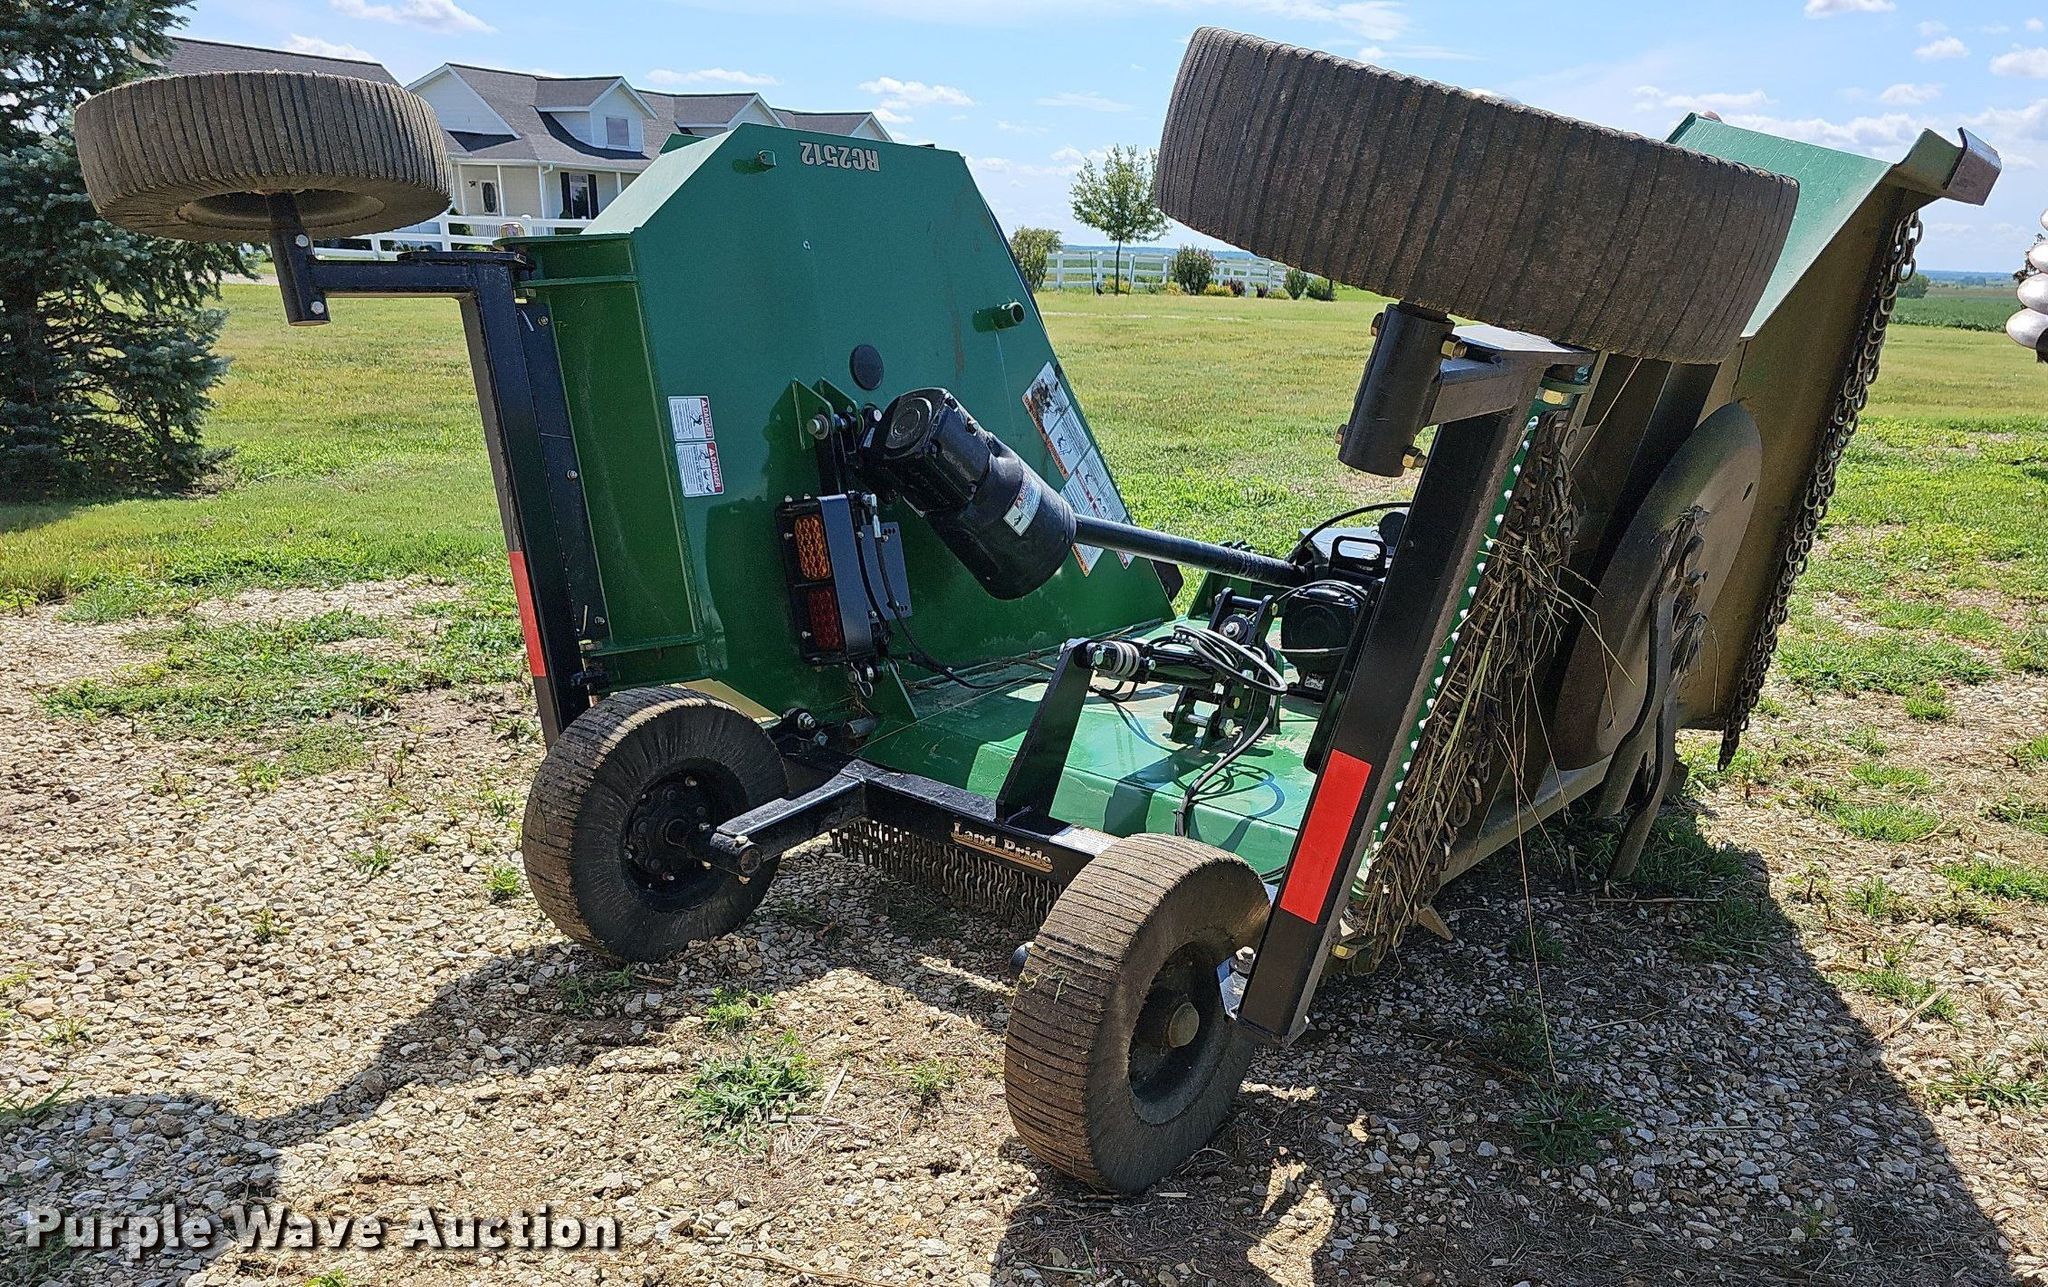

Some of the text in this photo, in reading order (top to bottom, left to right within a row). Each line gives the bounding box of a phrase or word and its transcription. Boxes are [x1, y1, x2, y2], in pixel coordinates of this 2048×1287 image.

[799, 142, 880, 171] RC2512
[702, 407, 712, 438] DANGER
[710, 457, 721, 489] DANGER
[953, 822, 997, 847] Land
[1003, 838, 1052, 865] Pride
